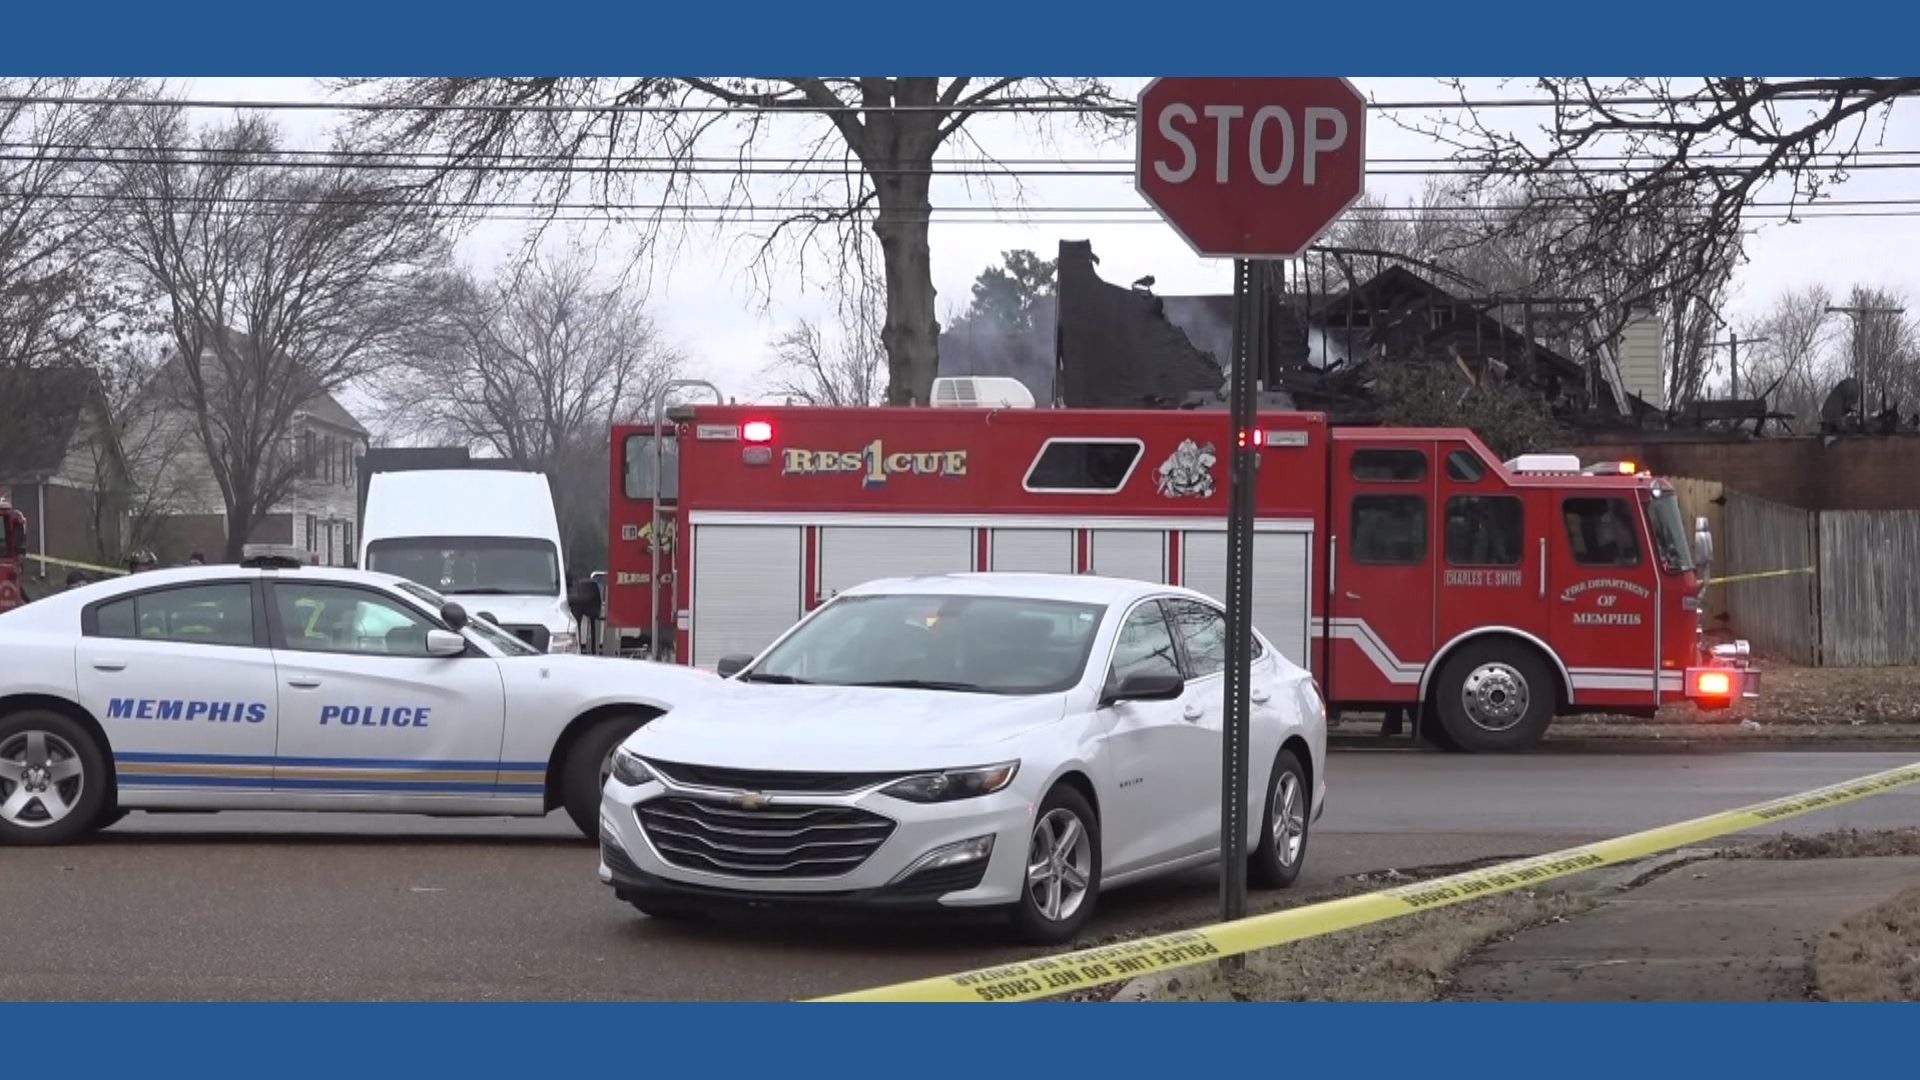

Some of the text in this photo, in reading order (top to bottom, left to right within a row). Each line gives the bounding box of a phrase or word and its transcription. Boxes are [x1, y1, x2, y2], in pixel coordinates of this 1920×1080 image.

[1153, 102, 1348, 187] STOP
[1446, 570, 1482, 586] CHARLES
[1495, 570, 1521, 586] SMITH
[1565, 578, 1650, 599] FIRE DEPARTMENT
[1597, 595, 1617, 607] OF
[1573, 613, 1641, 625] MEMPHIS
[107, 698, 432, 727] MEMPHIS POLICE
[1552, 854, 1603, 872] POLICE
[975, 942, 1219, 1001] POLICE LINE DO NOT CROSS
